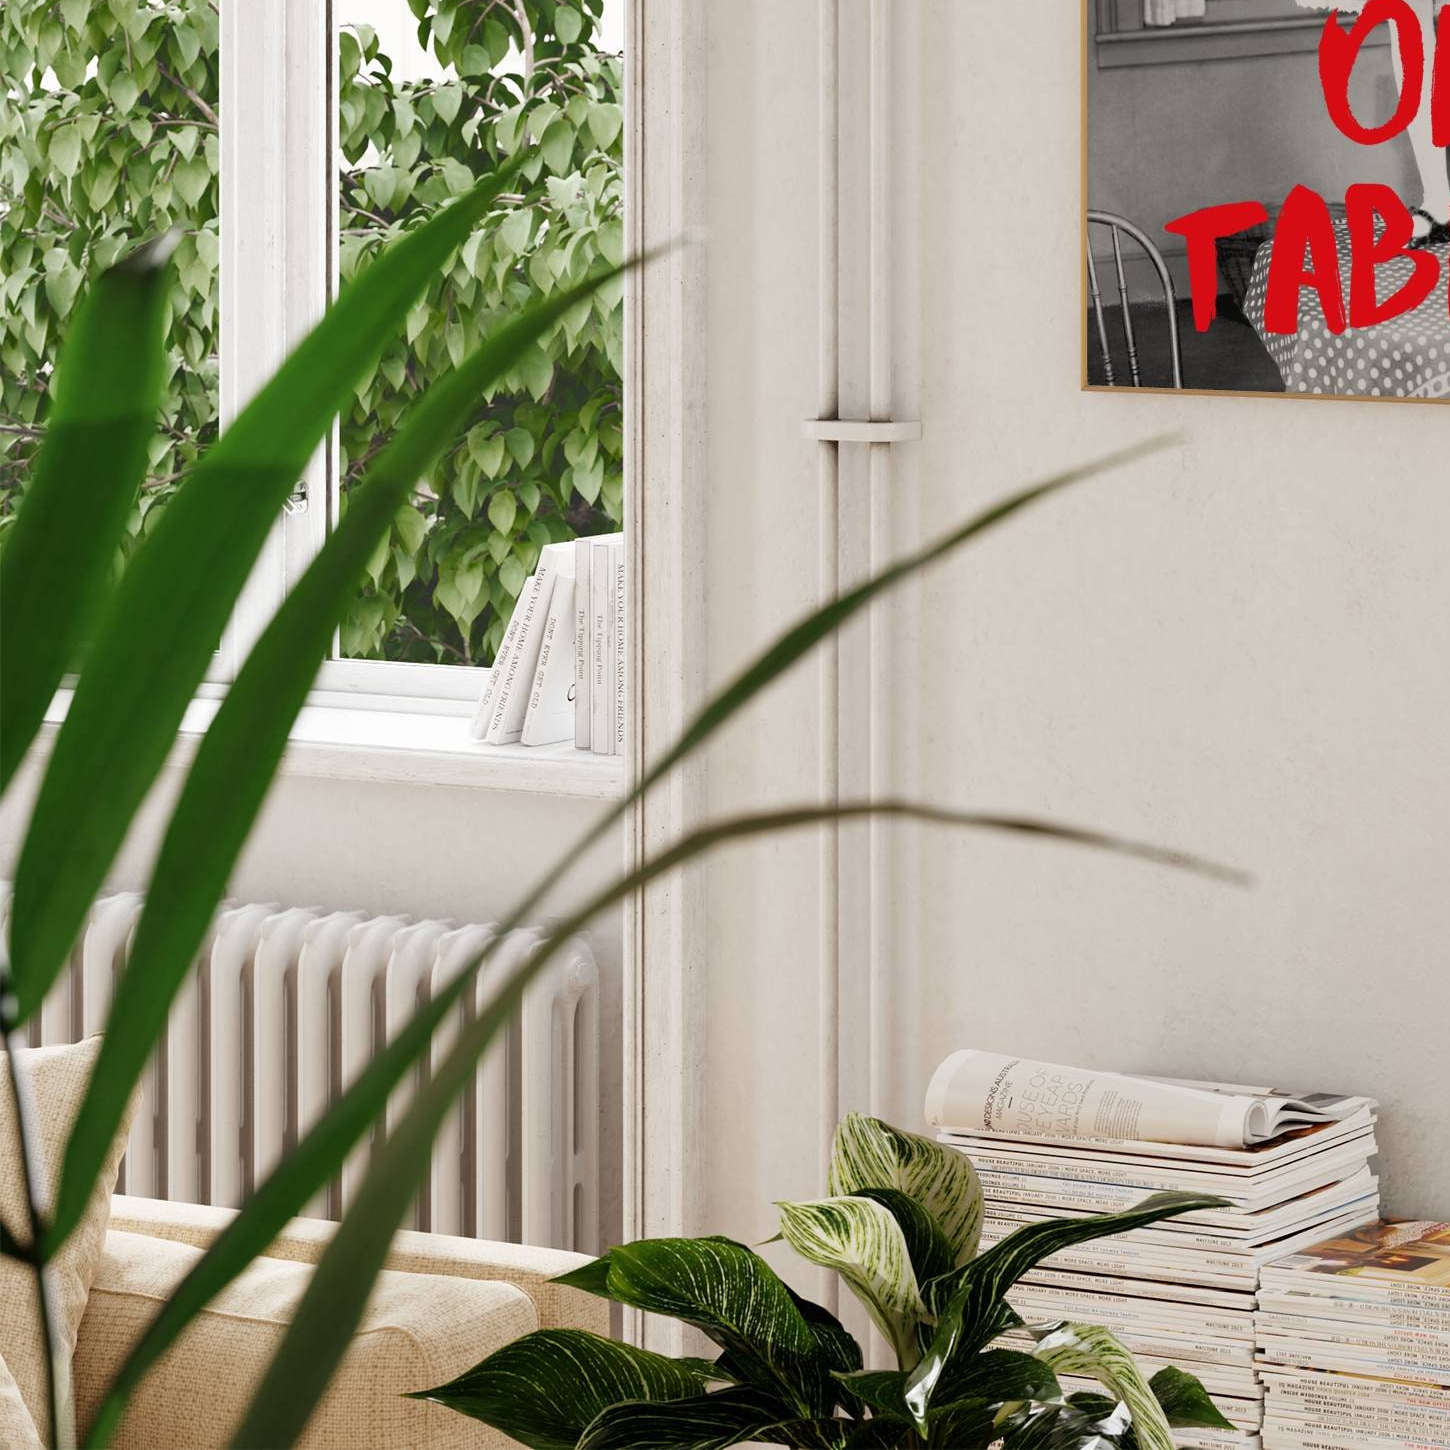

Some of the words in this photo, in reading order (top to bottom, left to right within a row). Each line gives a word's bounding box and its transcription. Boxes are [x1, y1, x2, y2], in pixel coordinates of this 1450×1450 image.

[532, 567, 546, 594] MAKE
[521, 596, 537, 622] YOUR
[514, 622, 530, 651] HOME
[503, 654, 520, 690] AMONG
[490, 690, 507, 731] FRIENDS
[995, 1079, 1013, 1120] MAGAZINE
